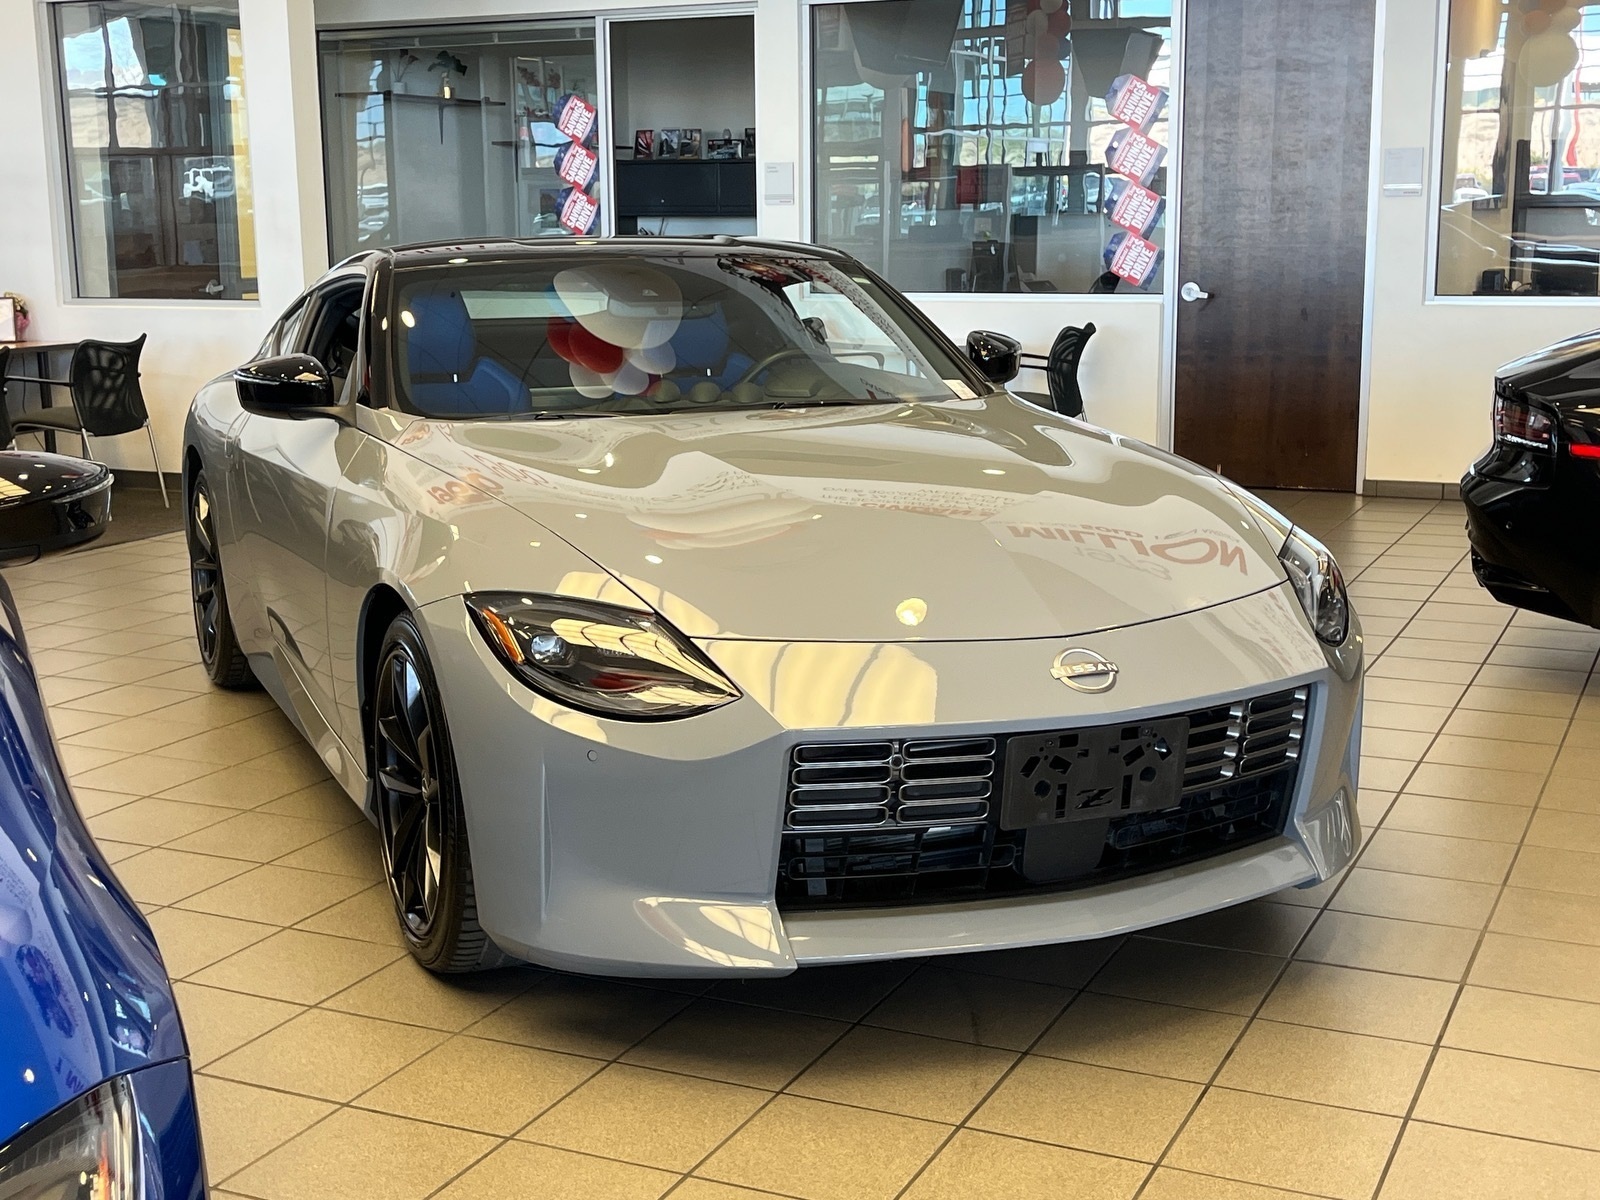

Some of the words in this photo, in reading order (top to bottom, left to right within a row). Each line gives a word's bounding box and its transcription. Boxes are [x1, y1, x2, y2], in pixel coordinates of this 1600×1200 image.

[564, 101, 585, 136] SAVINGS
[1120, 82, 1147, 122] SAVINGS
[1131, 90, 1155, 124] DRIVE
[574, 108, 592, 138] DRIVE
[566, 148, 586, 183] SAVINGS
[575, 155, 593, 185] DRIVE
[1120, 134, 1147, 174] SAVINGS
[1131, 143, 1155, 177] DRIVE
[567, 195, 588, 229] SAVINGS
[576, 201, 594, 231] DRIVE
[1120, 187, 1146, 227] SAVINGS
[1131, 196, 1155, 230] DRIVE
[1119, 238, 1145, 278] SAVINGS
[1129, 247, 1154, 280] DRIVE
[1052, 662, 1118, 678] NISSAN
